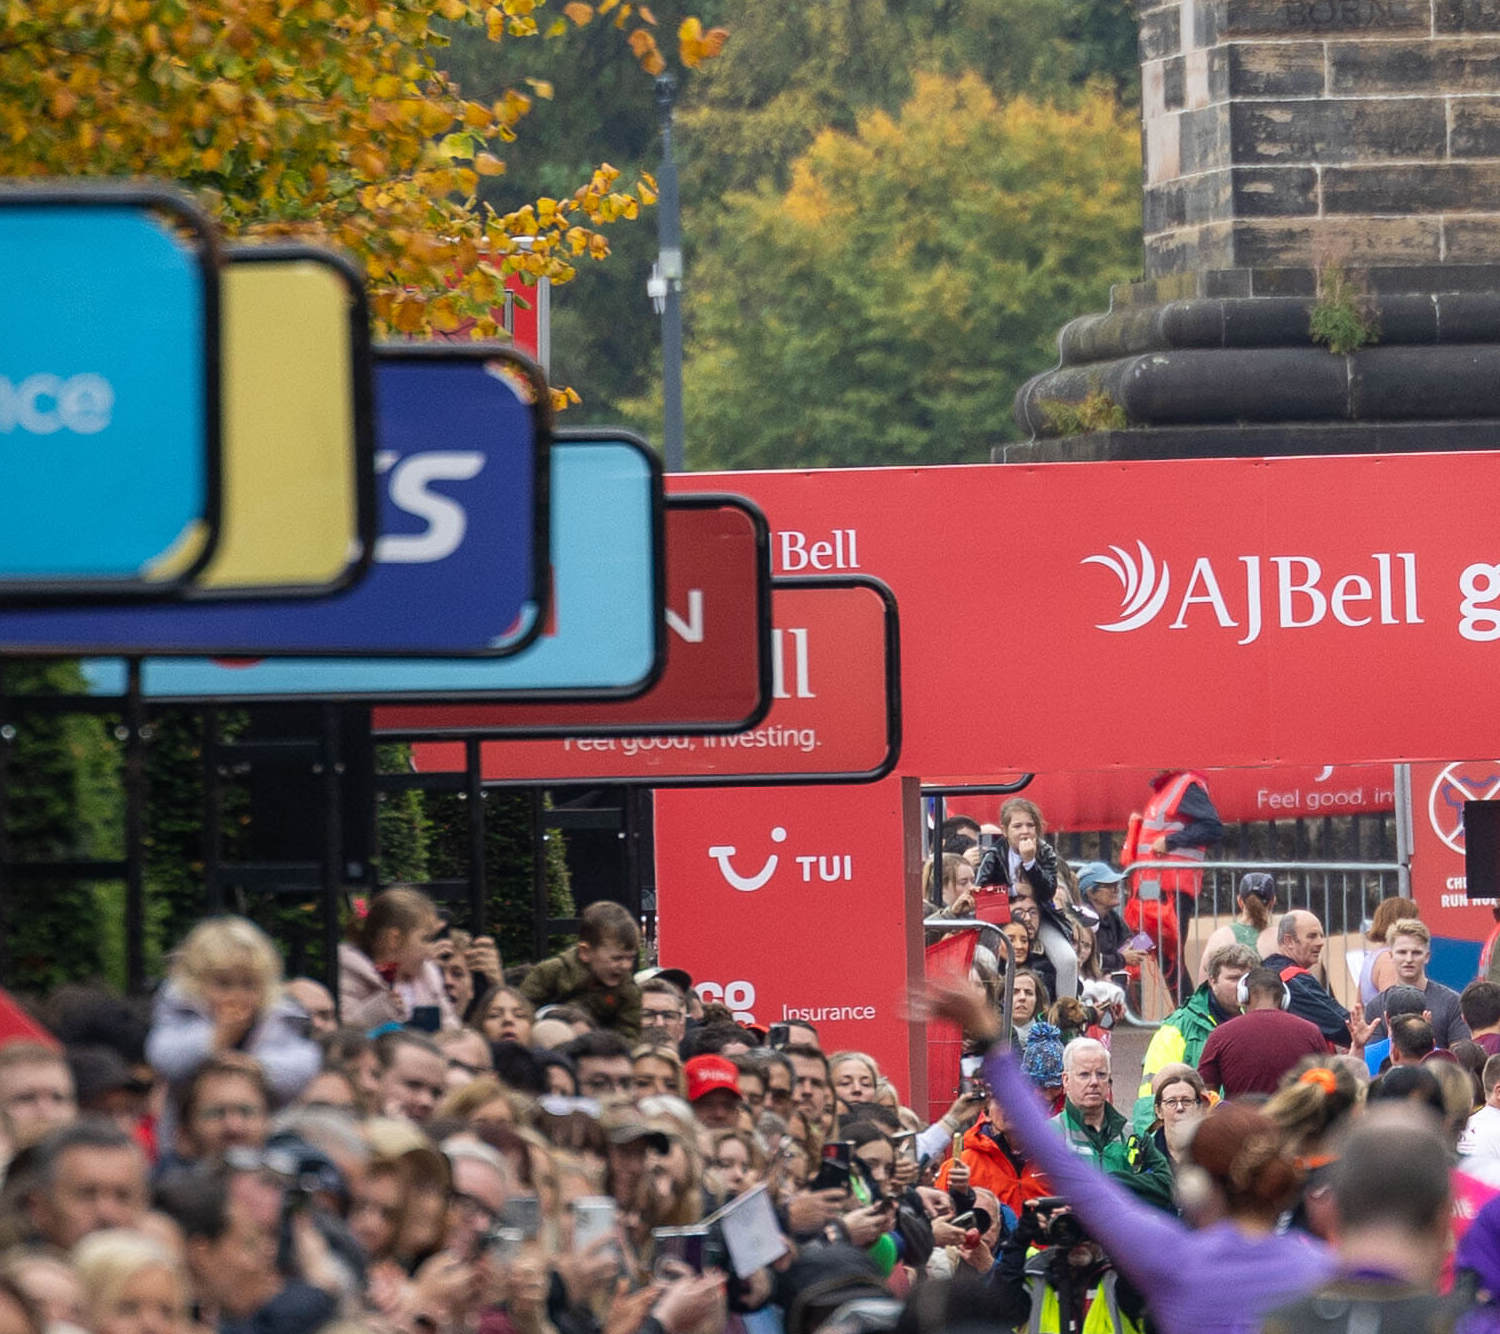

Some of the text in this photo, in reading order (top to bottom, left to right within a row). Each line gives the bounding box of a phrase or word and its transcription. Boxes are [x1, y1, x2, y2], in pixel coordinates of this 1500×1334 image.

[1168, 552, 1425, 646] AJBell
[702, 723, 823, 752] investing.
[1257, 788, 1300, 809] Feel
[1306, 784, 1367, 811] good,
[795, 854, 853, 883] TUI
[1441, 894, 1468, 908] RUN
[781, 1003, 877, 1022] Insurance
